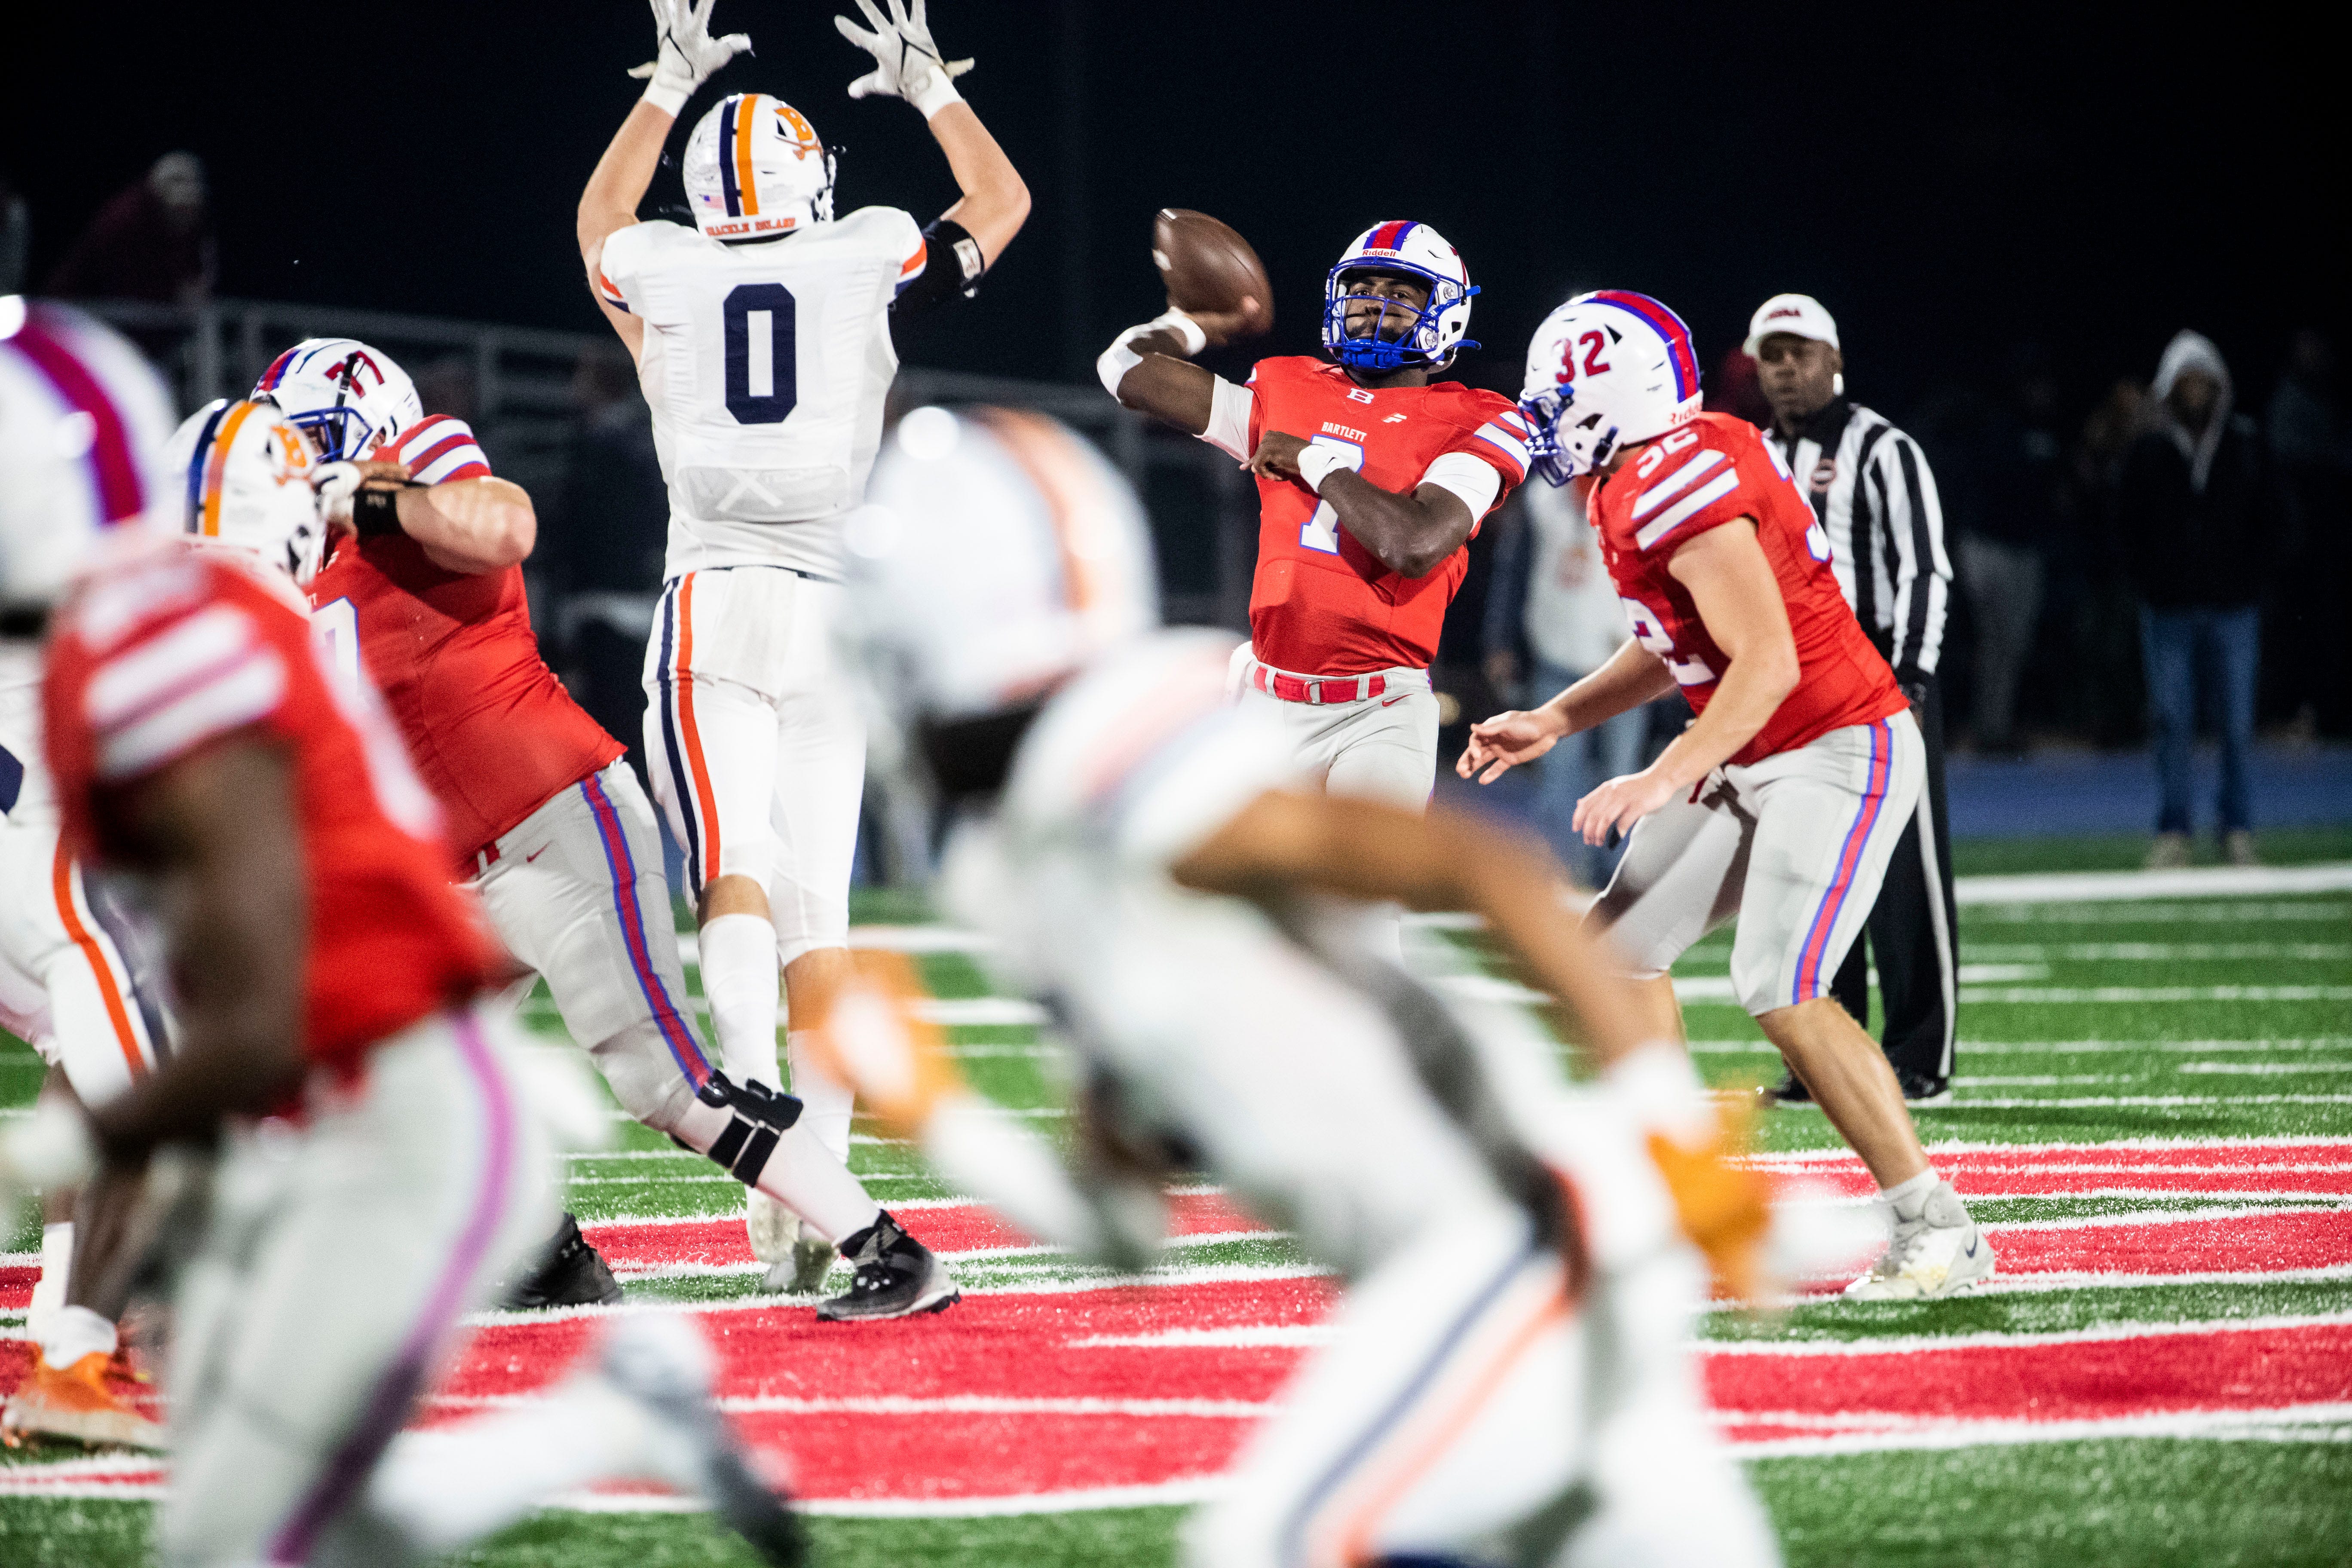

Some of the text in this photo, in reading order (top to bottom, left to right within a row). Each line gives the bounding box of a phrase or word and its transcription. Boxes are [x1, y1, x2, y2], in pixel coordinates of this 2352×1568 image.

[723, 282, 797, 425] 0
[1550, 329, 1611, 384] 32
[1346, 387, 1375, 404] B
[1321, 421, 1367, 442] BARTLETT
[1298, 434, 1365, 556] 7
